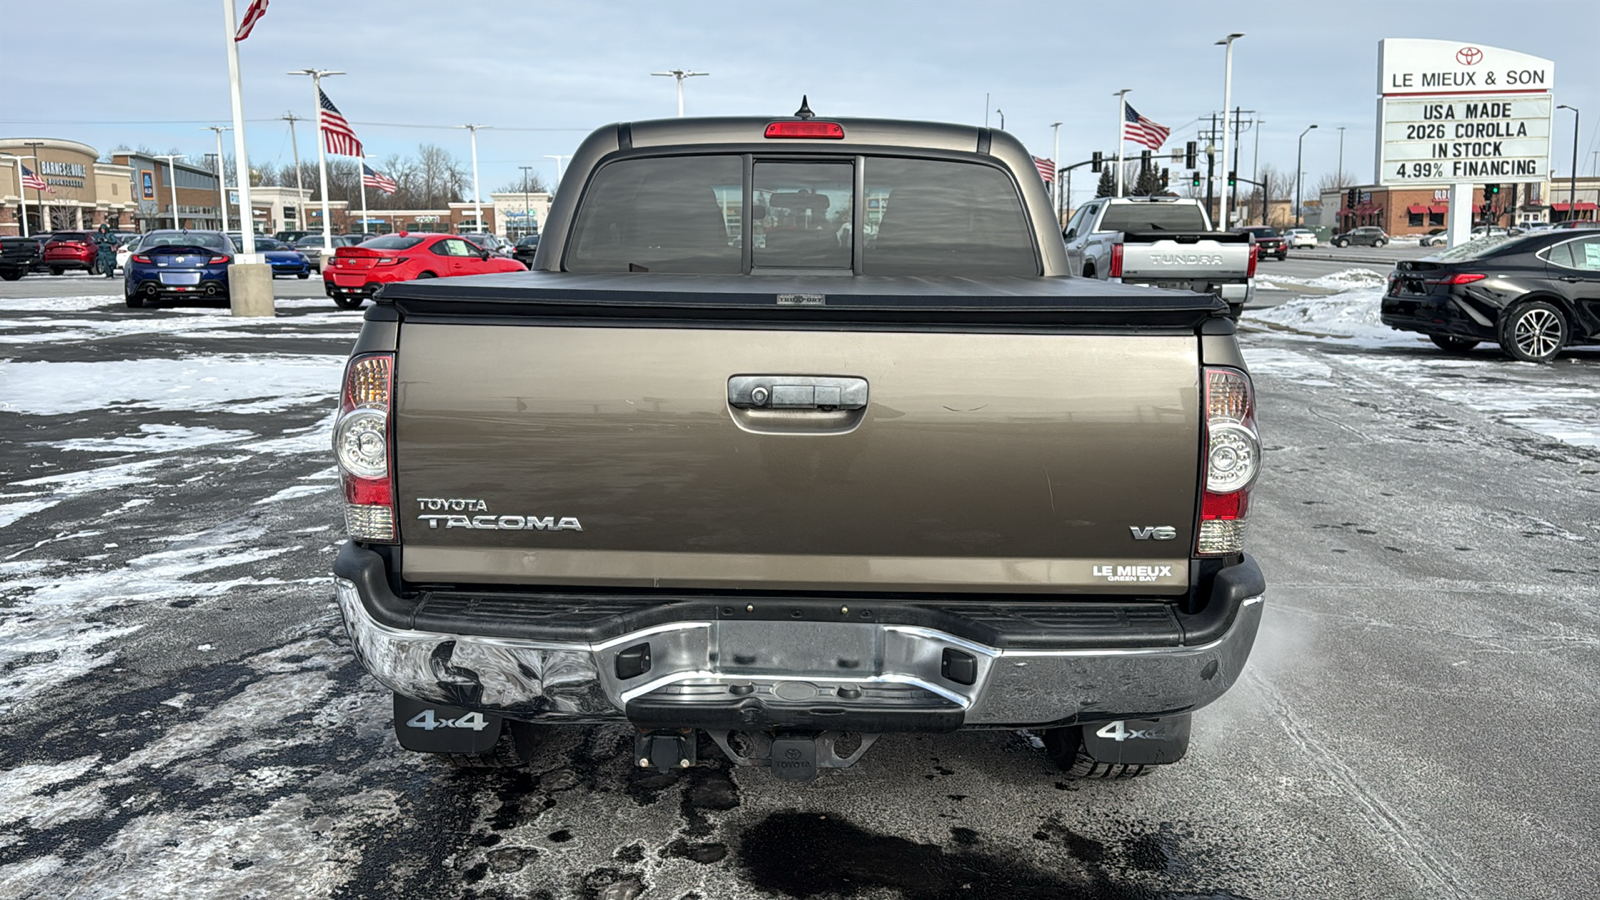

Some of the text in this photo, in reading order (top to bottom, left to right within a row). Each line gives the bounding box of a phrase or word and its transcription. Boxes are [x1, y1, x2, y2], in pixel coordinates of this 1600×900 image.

[1392, 70, 1545, 88] LE MIEUX & SON
[1423, 102, 1512, 120] USA MADE
[1407, 121, 1528, 140] 2026 COROLLA
[1432, 141, 1503, 158] IN STOCK
[1396, 160, 1537, 178] 4.99% FINANCING
[1150, 254, 1223, 265] TUNDRA
[417, 498, 488, 512] TOYOTA
[417, 514, 584, 532] TACOMA
[1129, 525, 1177, 540] V6
[1093, 565, 1172, 577] LE MIEUX
[776, 761, 812, 769] TOYOTA
